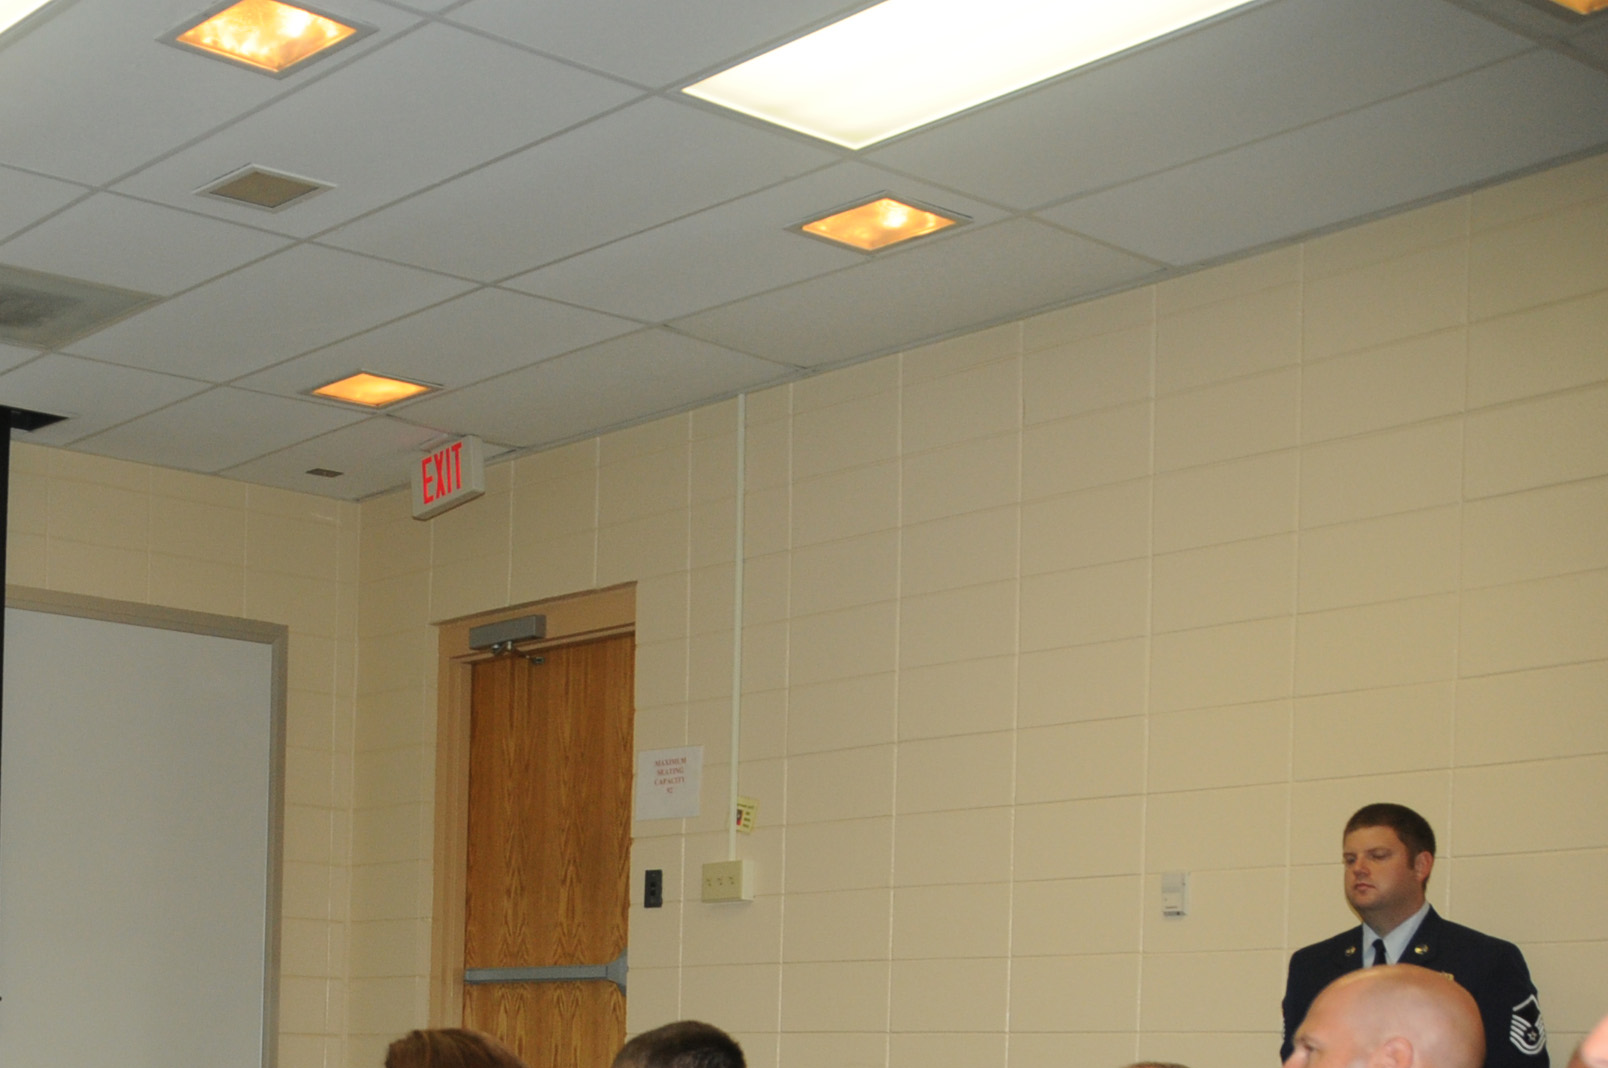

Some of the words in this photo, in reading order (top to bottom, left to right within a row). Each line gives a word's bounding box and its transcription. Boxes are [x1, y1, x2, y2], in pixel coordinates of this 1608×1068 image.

[421, 441, 463, 505] EXIT
[655, 757, 687, 767] MAXIMUM
[657, 767, 684, 775] SEATING
[654, 776, 685, 786] CAPACITY
